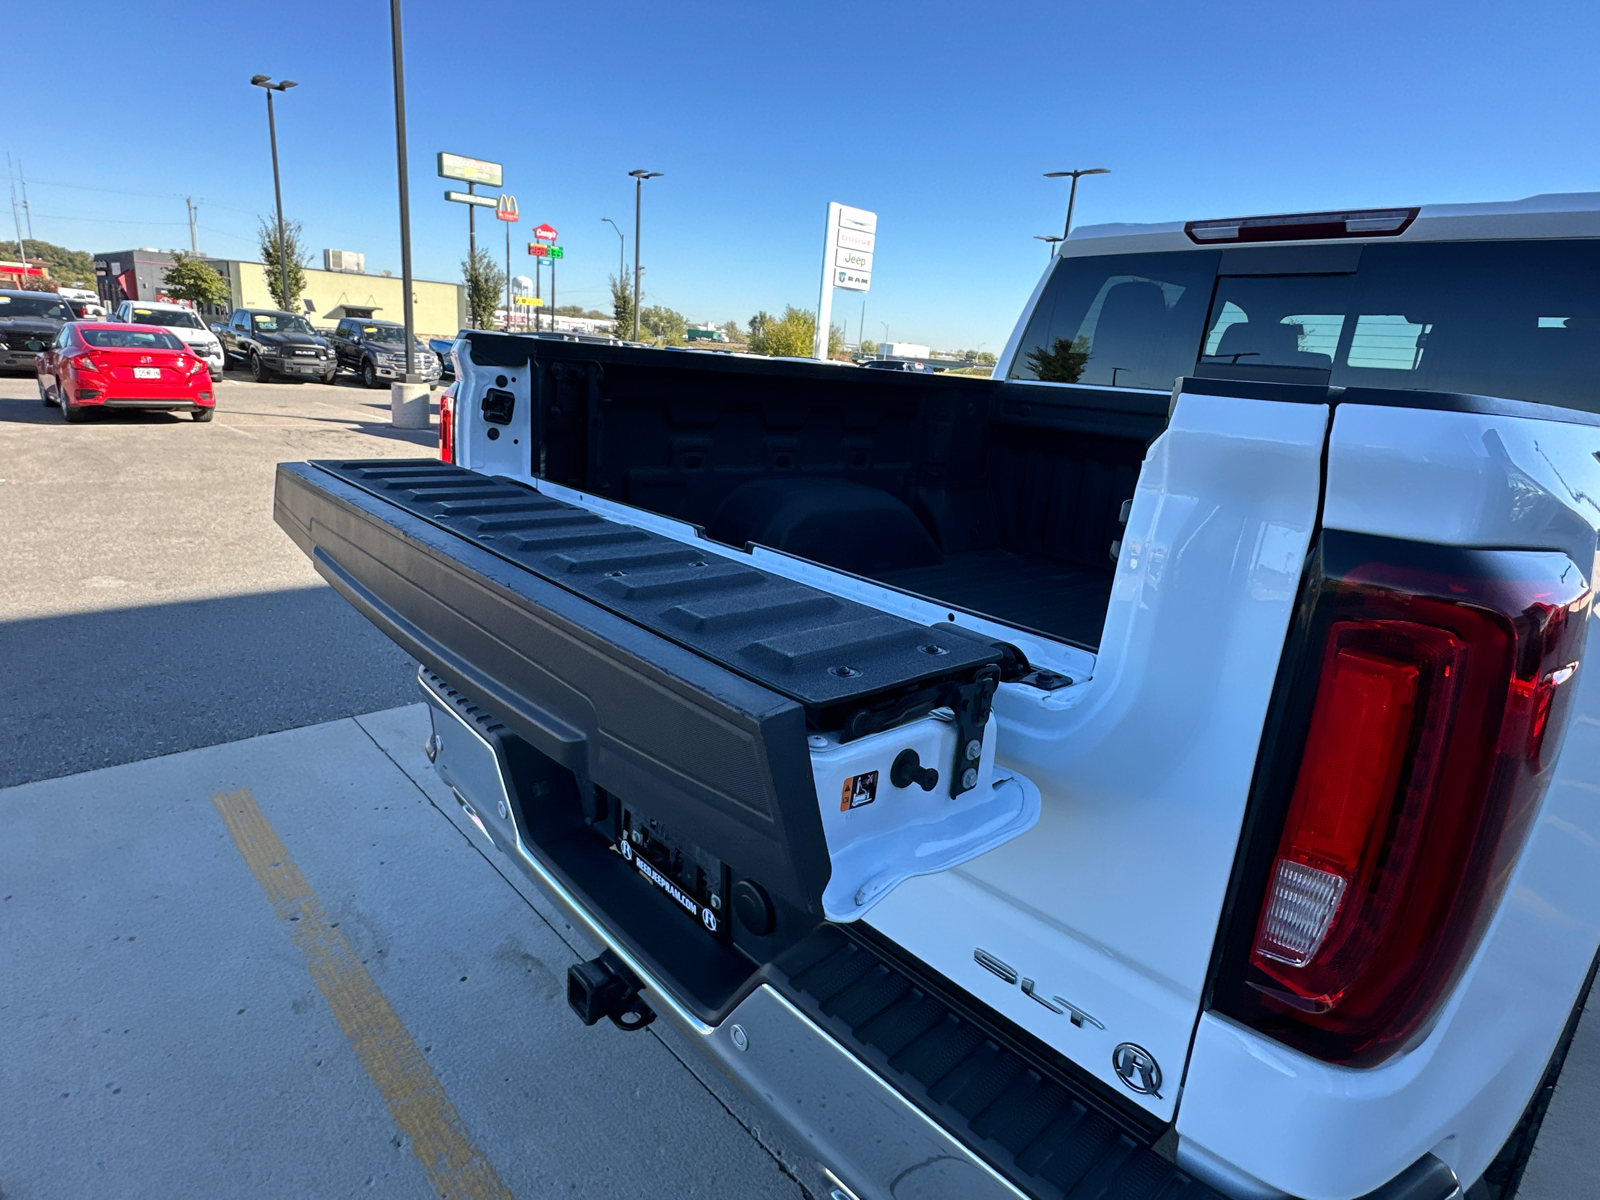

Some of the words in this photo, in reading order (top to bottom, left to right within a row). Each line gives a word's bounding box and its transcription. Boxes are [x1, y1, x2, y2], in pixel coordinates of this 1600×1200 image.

[842, 234, 871, 246] DODGE
[844, 252, 866, 267] Jeep
[847, 276, 868, 284] RAM
[636, 857, 697, 915] REEDJEEPRAM.COM
[973, 946, 1107, 1031] SLT
